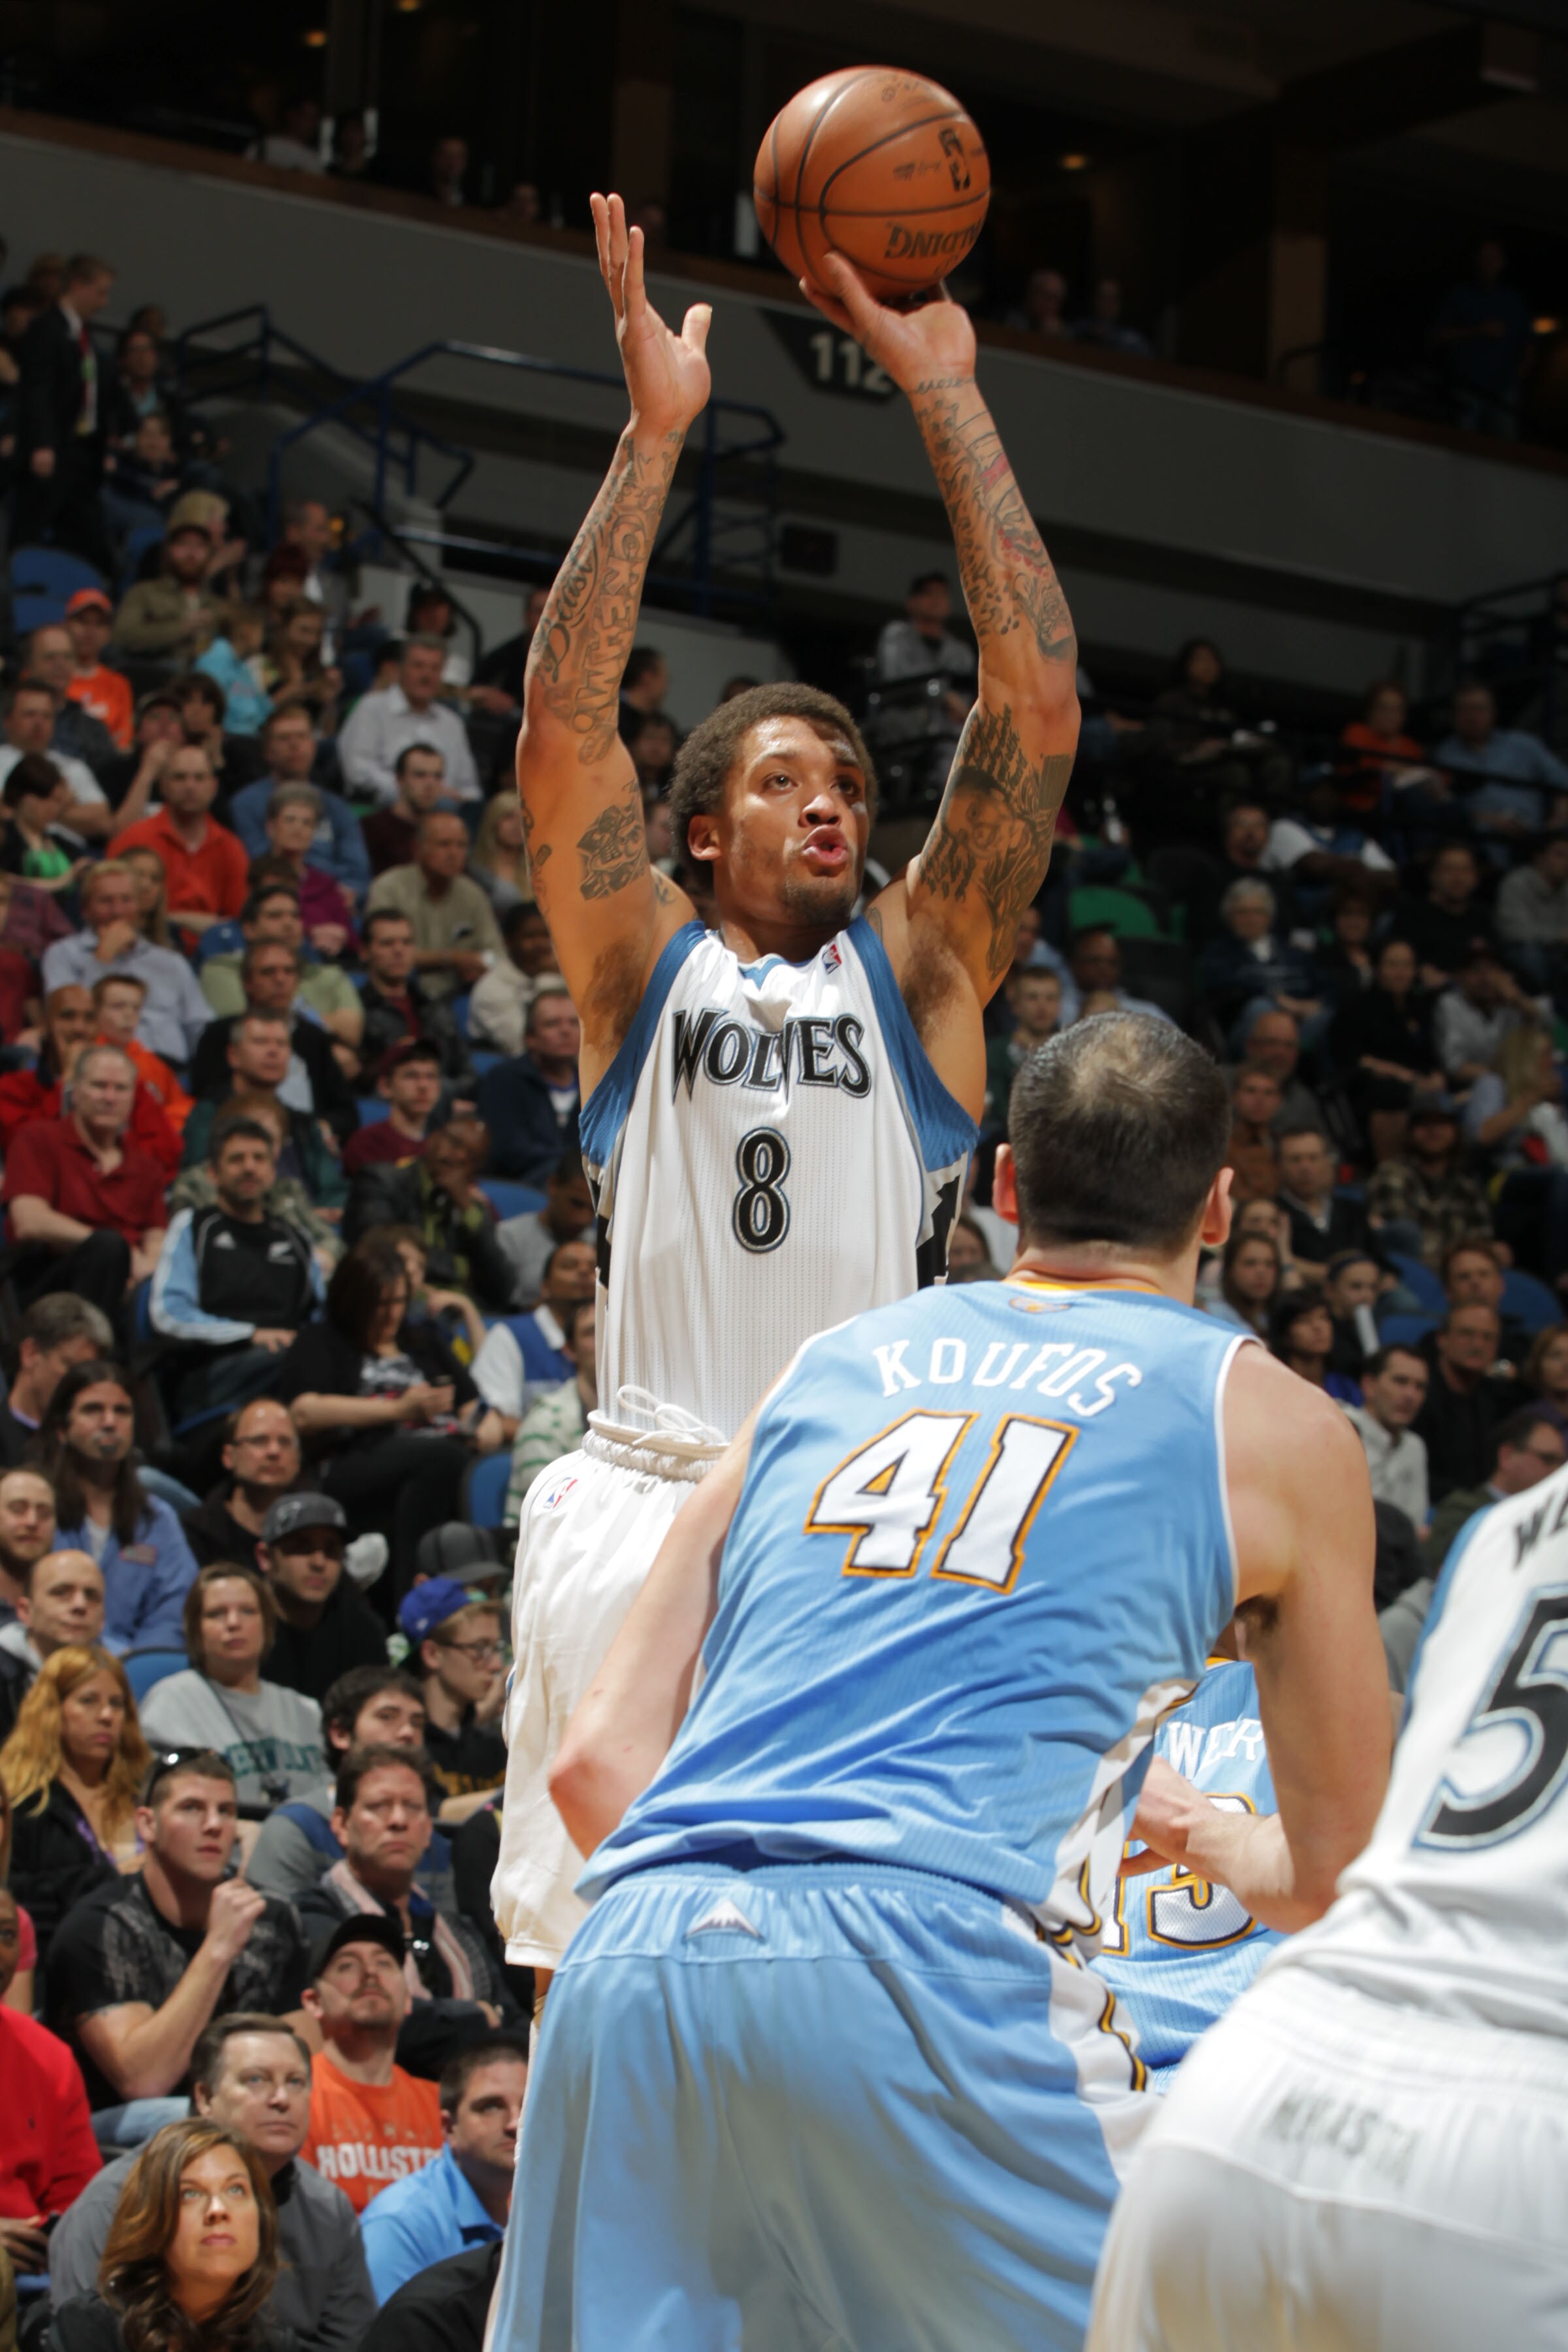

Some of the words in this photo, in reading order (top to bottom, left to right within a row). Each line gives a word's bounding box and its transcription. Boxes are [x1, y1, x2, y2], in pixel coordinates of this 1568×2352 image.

[885, 218, 984, 259] ALDING
[672, 1008, 872, 1107] WOLVES
[732, 1126, 791, 1253] 8
[873, 1337, 1143, 1417] KOUFOS
[803, 1409, 1080, 1595] 41
[1155, 1718, 1264, 1781] WER
[1411, 1584, 1568, 1853] 5
[316, 2141, 443, 2180] HOLLIST
